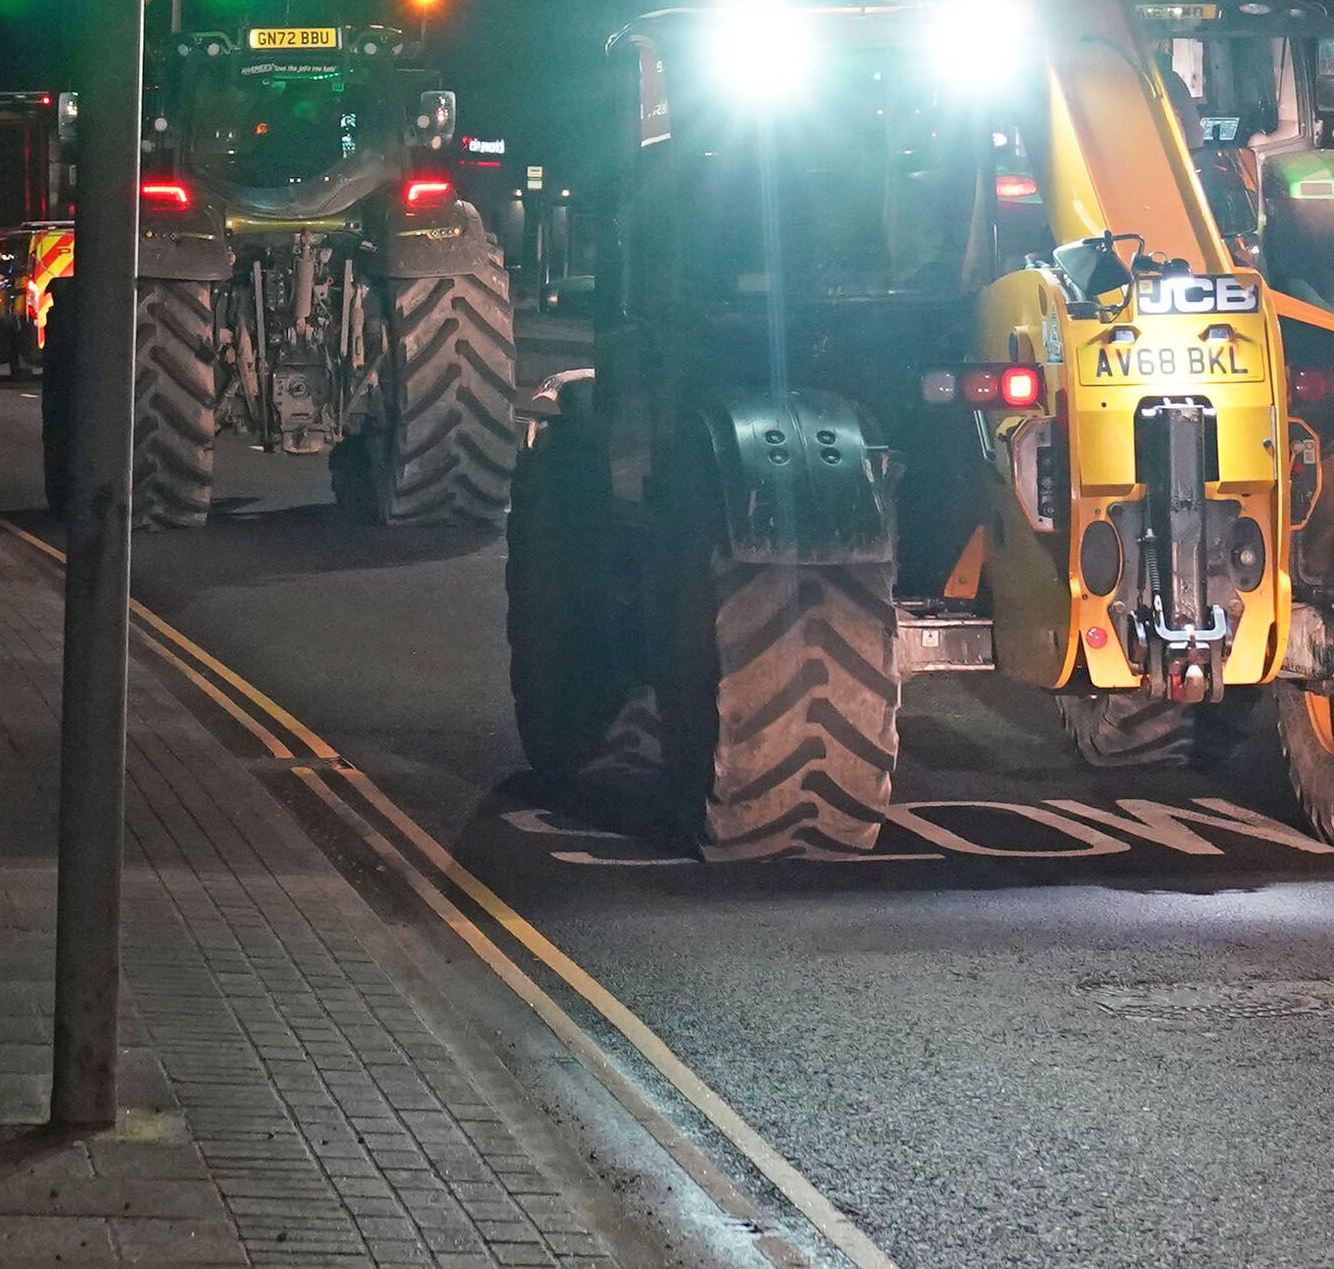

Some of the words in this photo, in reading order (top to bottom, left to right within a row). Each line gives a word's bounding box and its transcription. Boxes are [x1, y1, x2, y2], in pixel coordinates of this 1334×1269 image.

[257, 31, 297, 46] GN72
[300, 30, 330, 45] BBU
[1138, 277, 1258, 314] JCB
[1095, 346, 1176, 378] AV68
[1186, 345, 1250, 376] BKL
